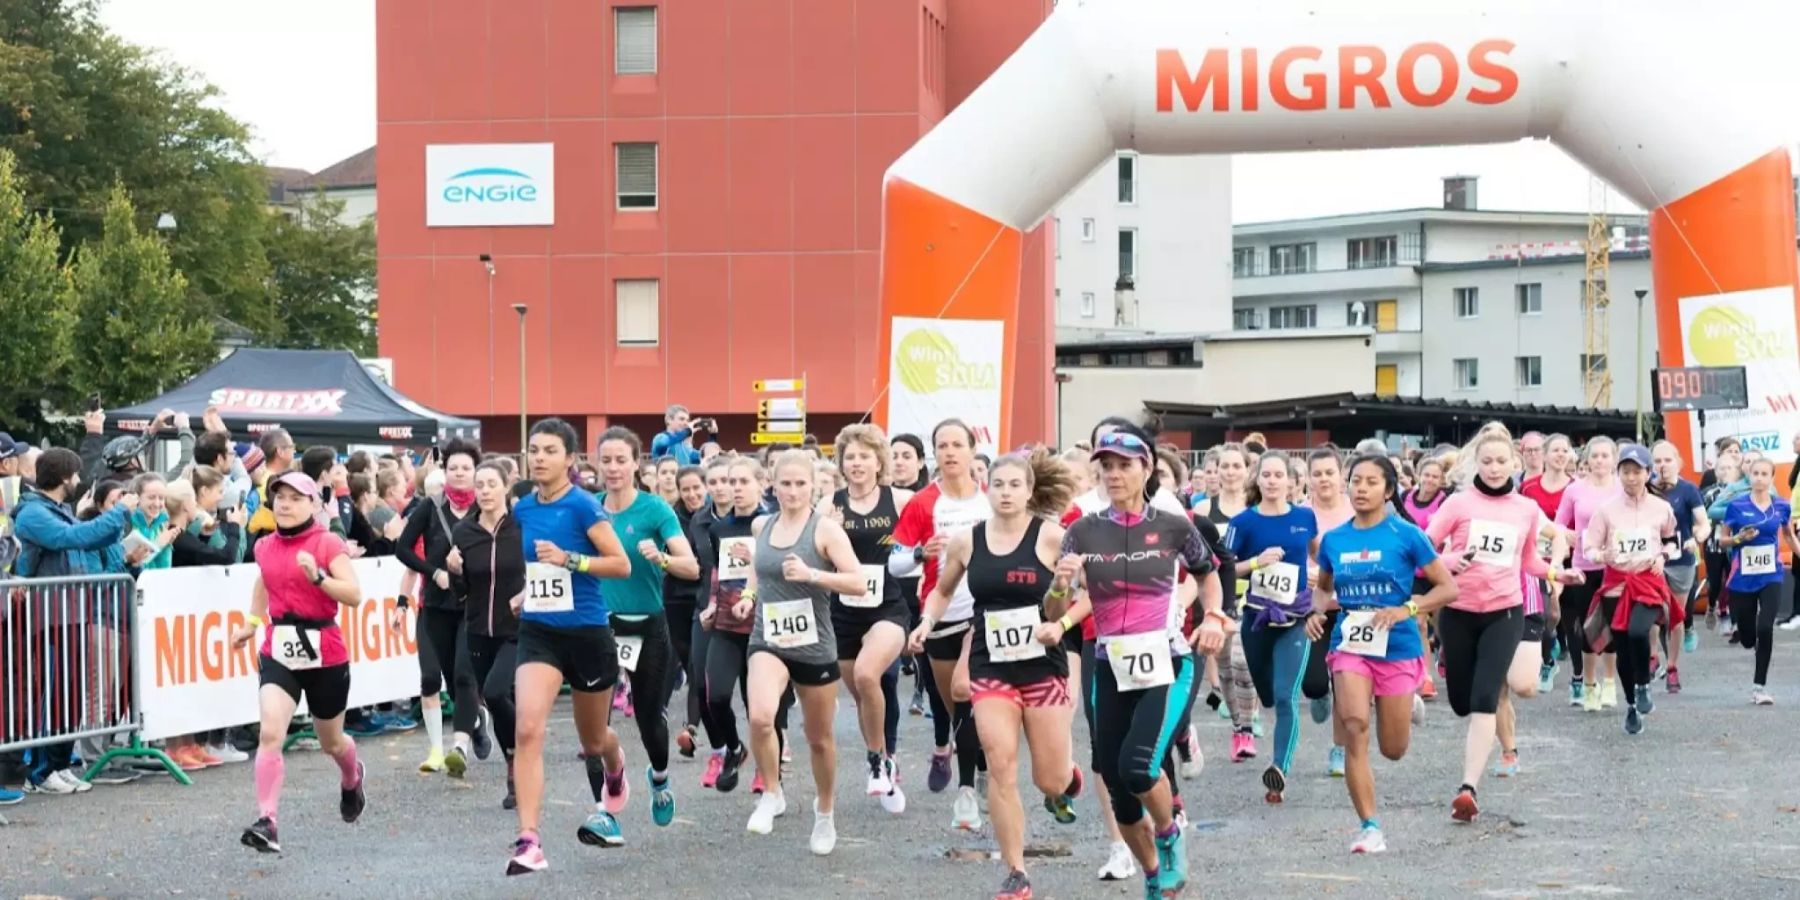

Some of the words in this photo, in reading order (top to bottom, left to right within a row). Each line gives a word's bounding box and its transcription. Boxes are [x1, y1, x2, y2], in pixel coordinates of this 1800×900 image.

[1156, 39, 1519, 112] MIGROS
[208, 387, 346, 413] SPORTXX
[1741, 435, 1779, 451] ASVZ
[1479, 534, 1504, 553] 15
[1617, 539, 1647, 553] 172
[1746, 555, 1771, 567] 146
[1007, 571, 1037, 584] STB
[1258, 572, 1292, 593] 143
[530, 578, 564, 599] 115
[770, 614, 808, 636] 140
[1349, 625, 1374, 643] 26
[155, 611, 269, 688] MIGR
[341, 595, 419, 664] IGRO
[992, 624, 1034, 649] 107
[1122, 652, 1155, 675] 70
